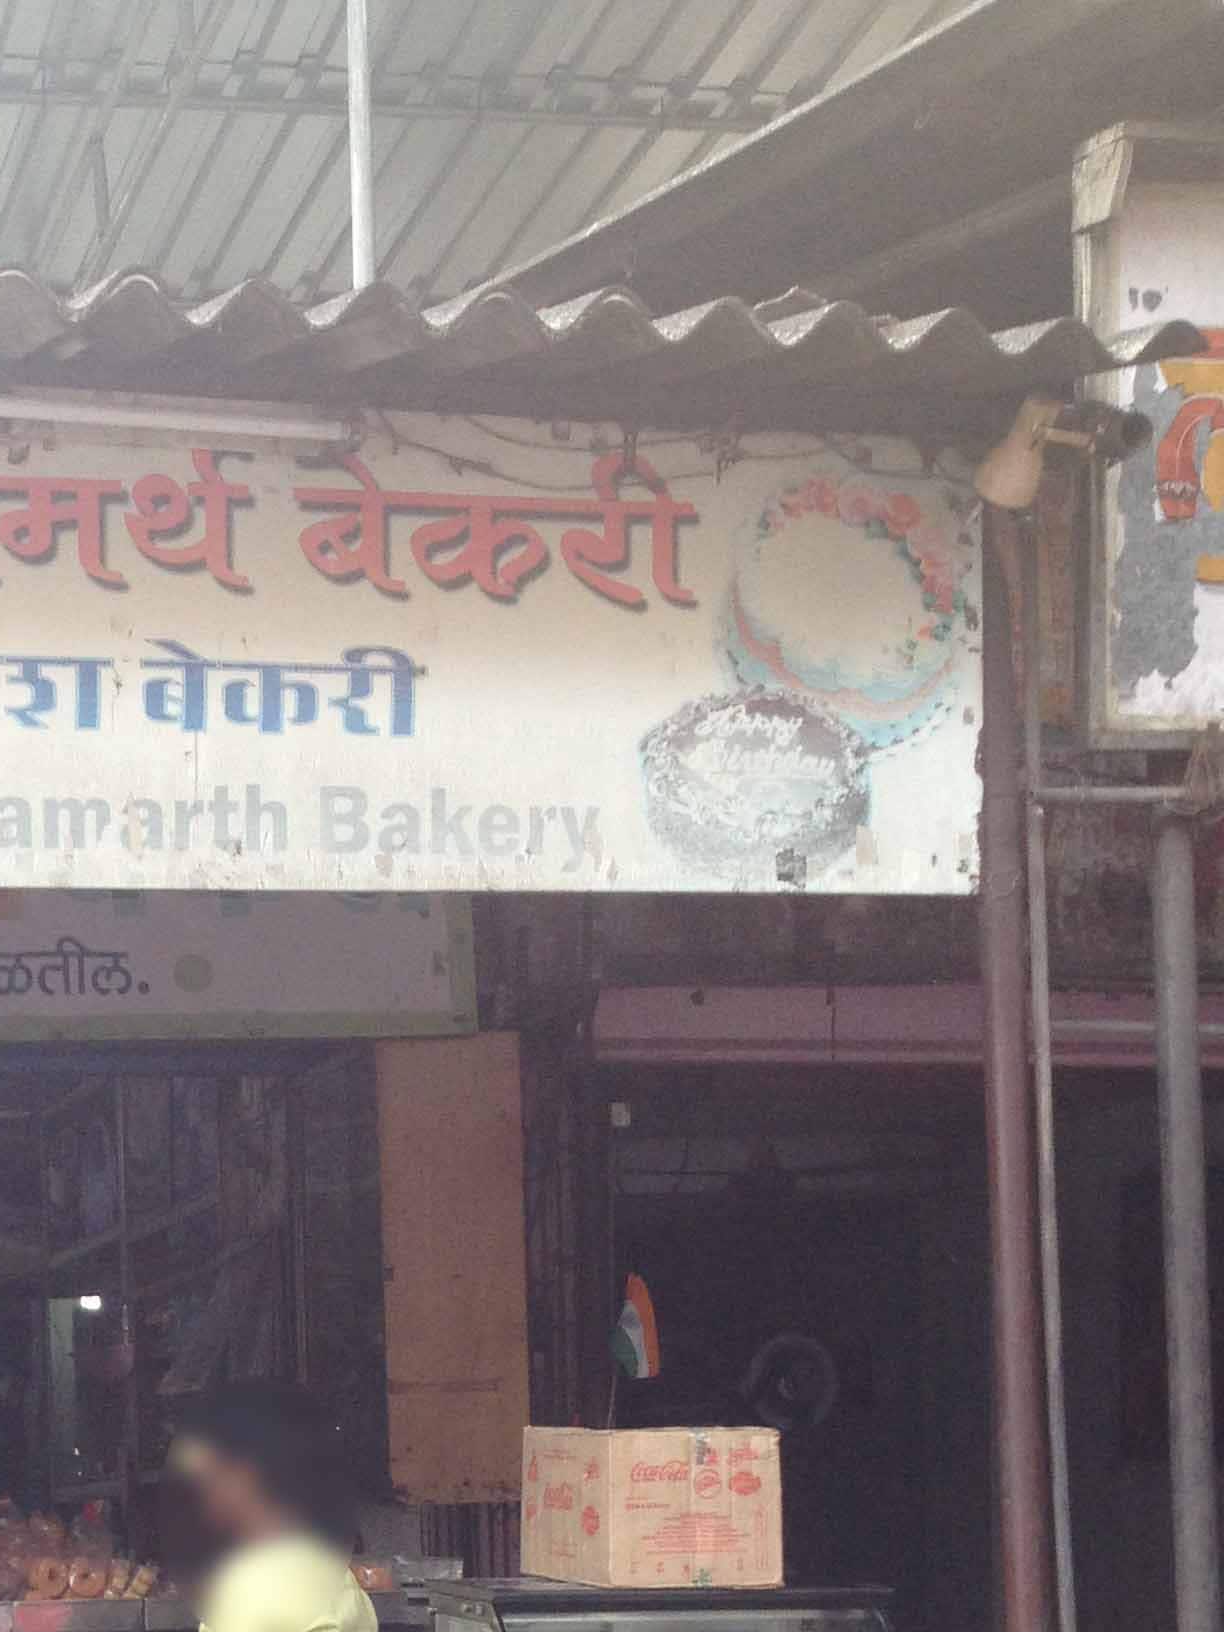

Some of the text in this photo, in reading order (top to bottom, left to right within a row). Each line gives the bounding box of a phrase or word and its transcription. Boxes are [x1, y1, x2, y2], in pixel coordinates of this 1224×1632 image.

[292, 450, 701, 610] बेकरी
[140, 636, 429, 737] बेकरी
[320, 784, 603, 873] Bakery
